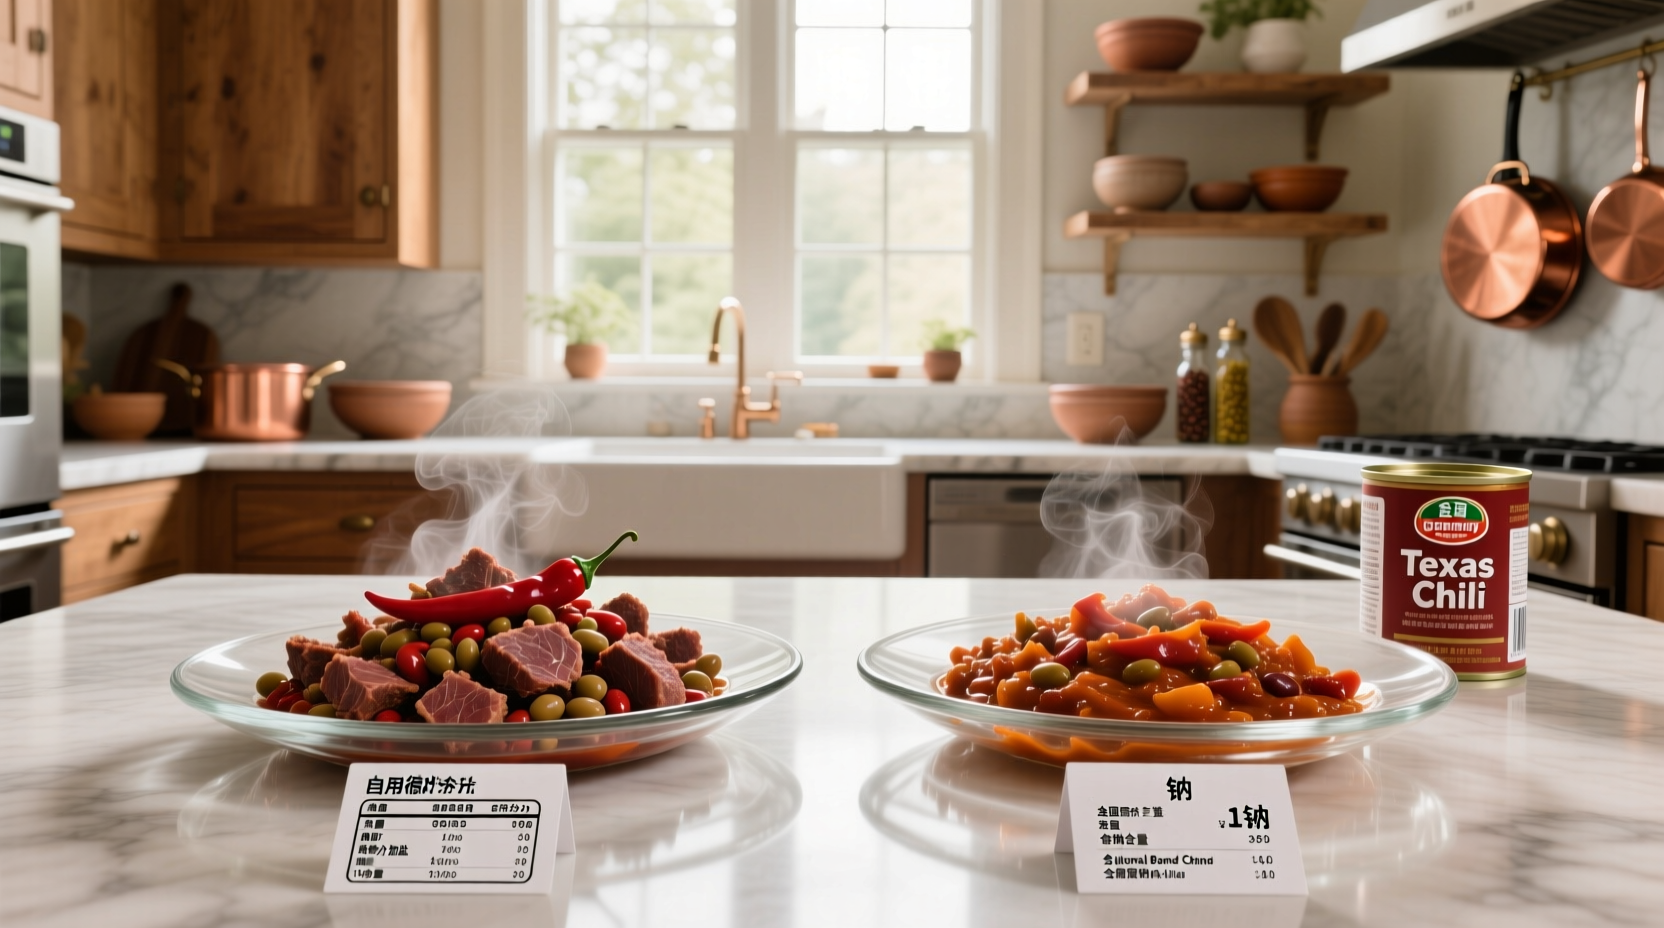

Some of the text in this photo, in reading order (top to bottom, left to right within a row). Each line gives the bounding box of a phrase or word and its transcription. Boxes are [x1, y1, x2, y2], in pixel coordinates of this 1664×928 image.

[1401, 549, 1494, 578] Texas
[1412, 580, 1486, 609] Chili
[1166, 776, 1192, 801] 钠
